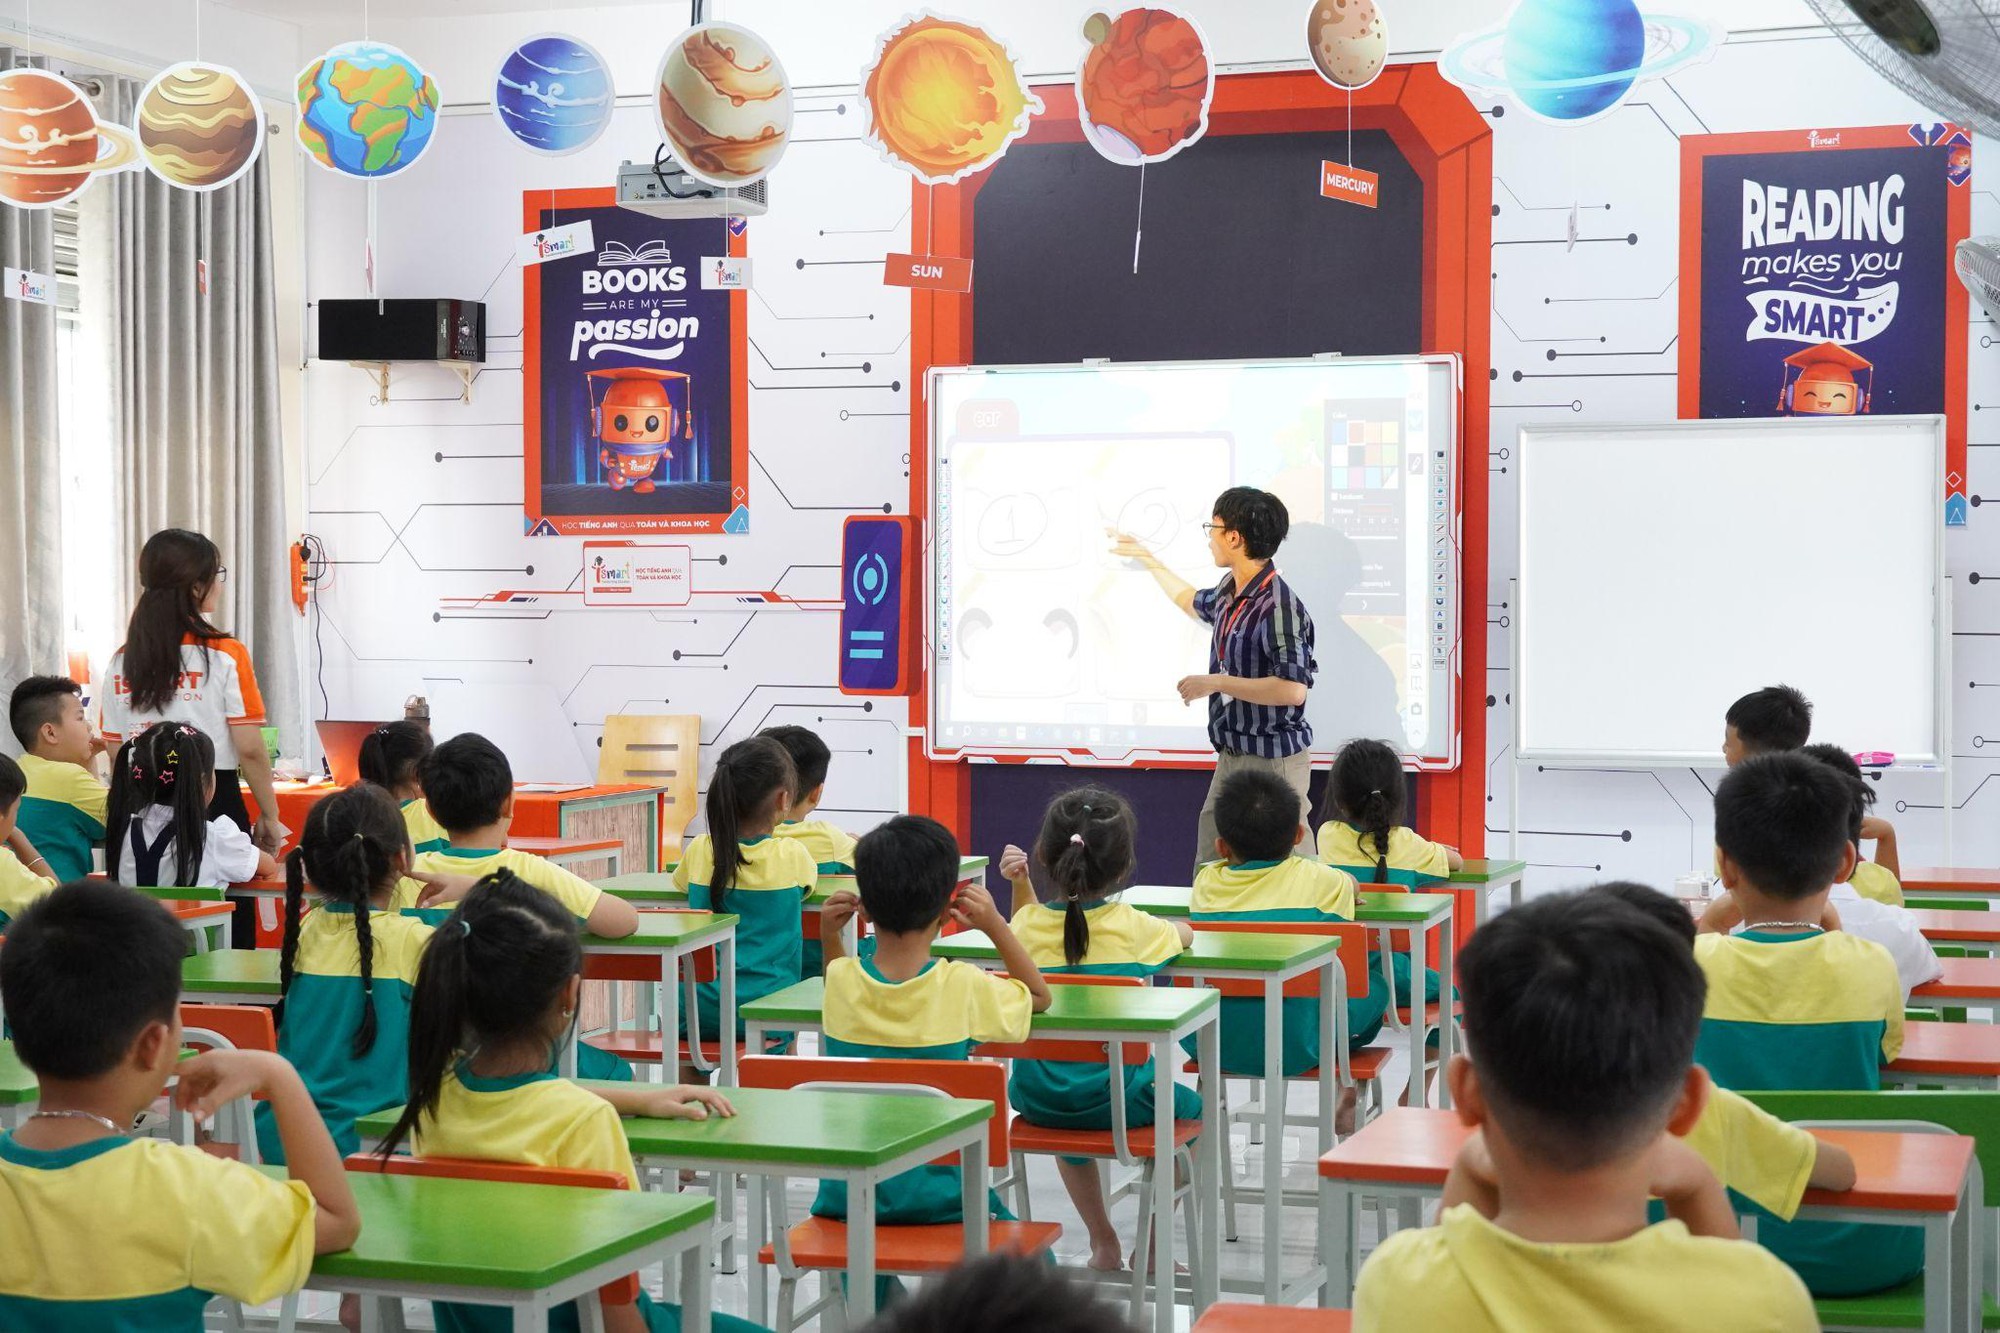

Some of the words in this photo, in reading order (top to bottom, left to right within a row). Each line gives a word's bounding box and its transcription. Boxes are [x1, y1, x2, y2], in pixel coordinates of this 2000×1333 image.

[1326, 172, 1375, 196] MERCURY
[1742, 174, 1906, 250] READING
[911, 264, 943, 279] SUN
[1741, 249, 1842, 276] makes
[1843, 251, 1904, 282] you
[582, 266, 687, 294] BOOKS
[609, 300, 635, 310] ARE
[640, 299, 659, 309] MY
[1764, 298, 1865, 341] SMART
[569, 308, 699, 361] passion
[620, 521, 635, 529] QUA
[114, 671, 203, 695] iSRT
